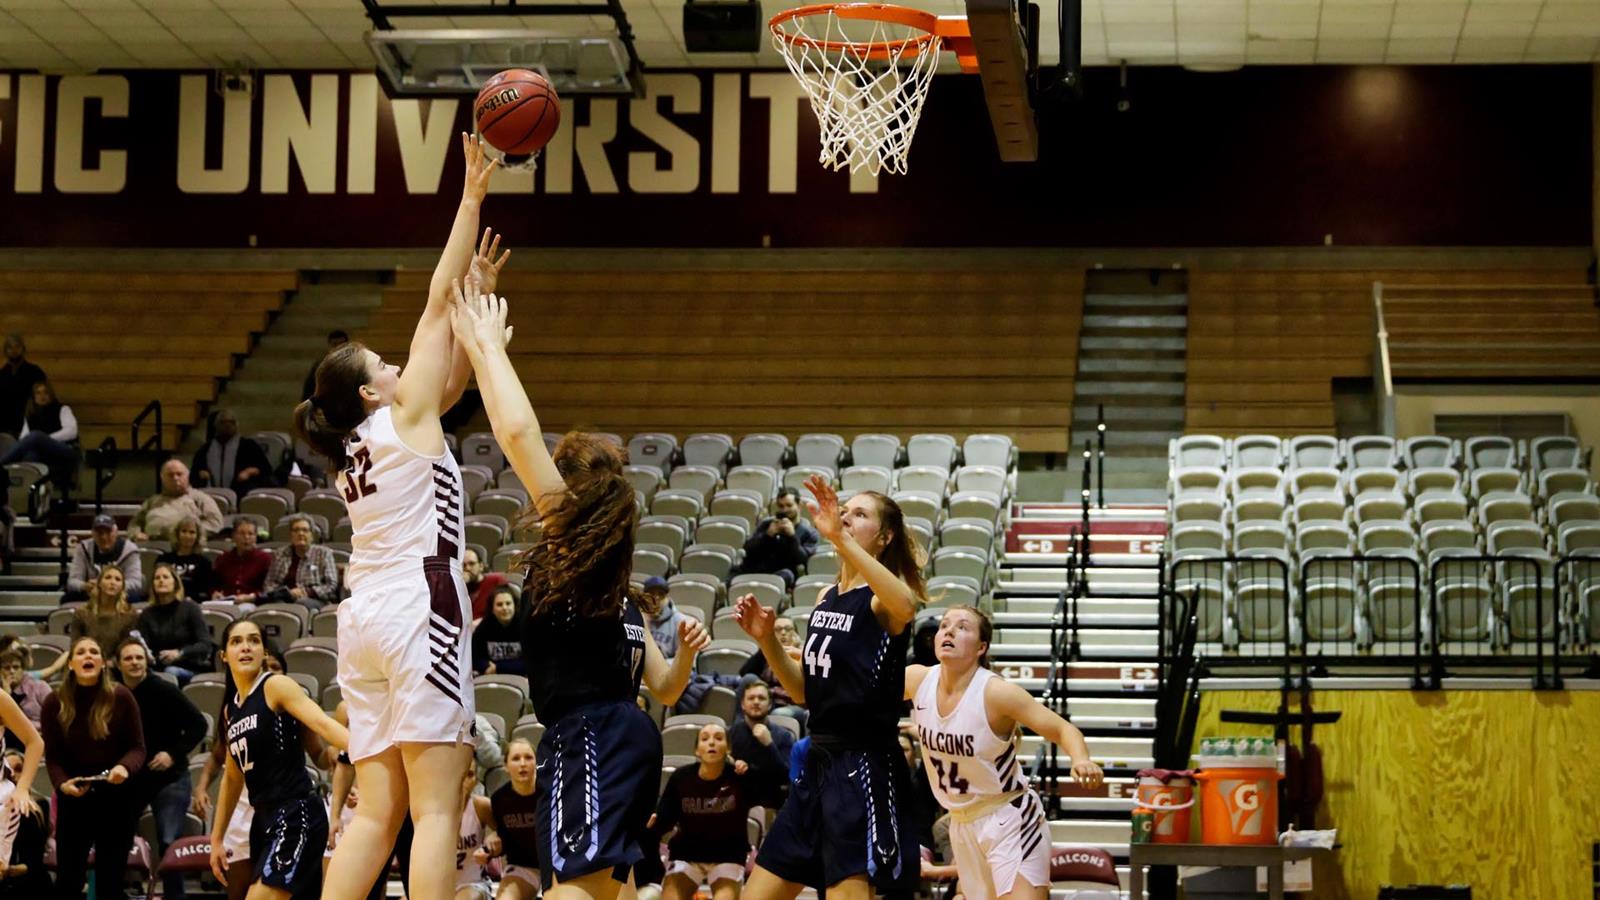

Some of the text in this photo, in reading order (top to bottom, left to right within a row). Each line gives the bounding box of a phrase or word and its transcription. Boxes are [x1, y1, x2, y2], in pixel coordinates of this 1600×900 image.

[804, 633, 833, 678] 44
[1235, 784, 1258, 810] G
[175, 844, 212, 858] FALCO
[1051, 853, 1105, 867] FALCONS
